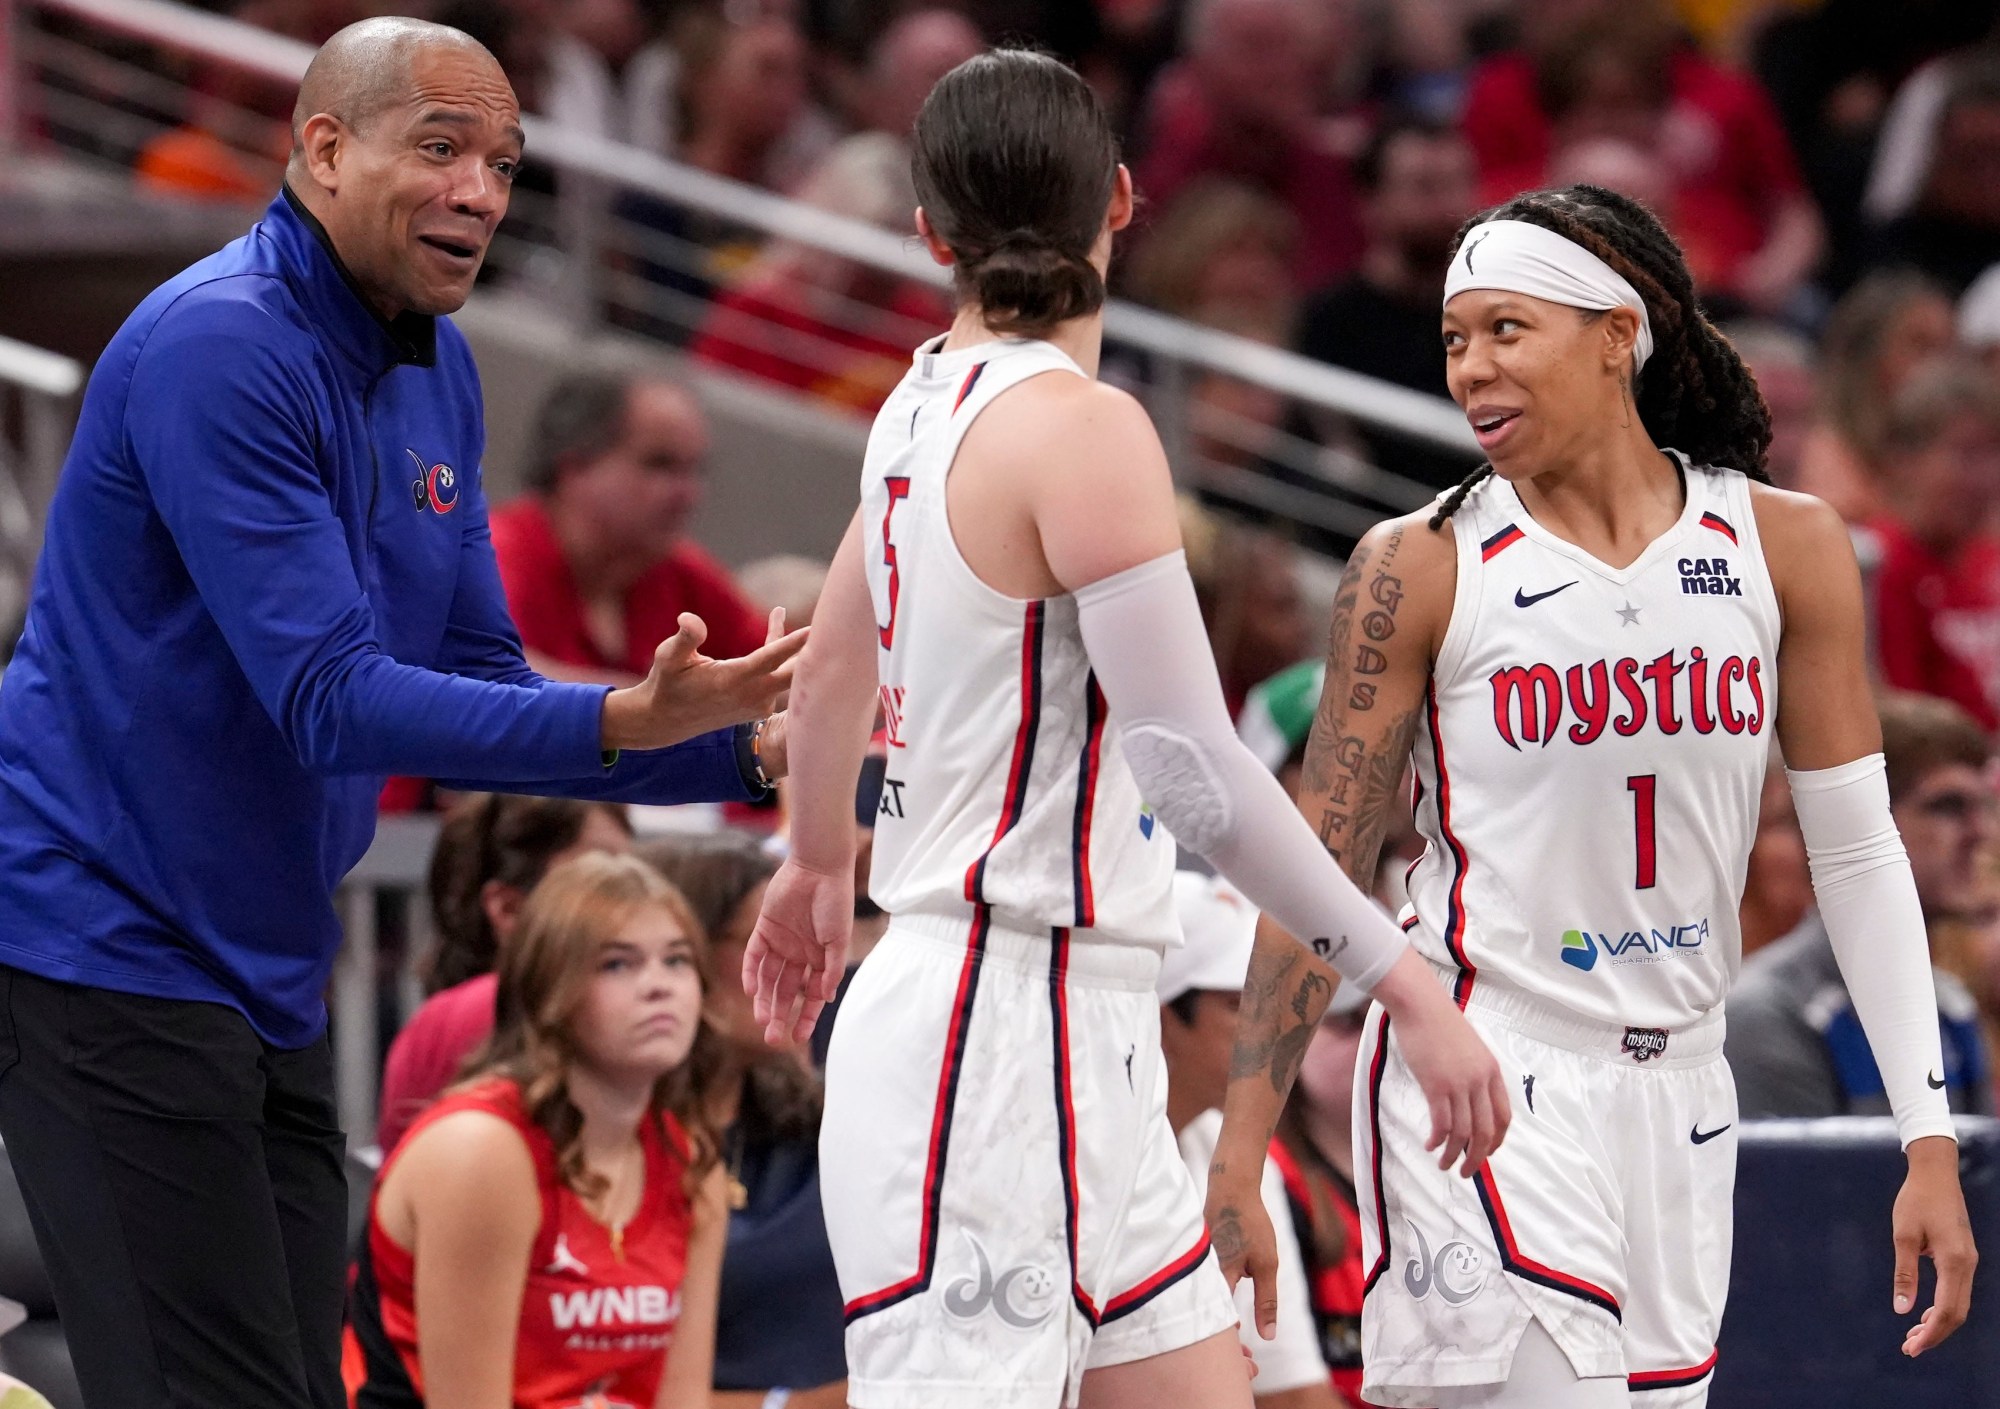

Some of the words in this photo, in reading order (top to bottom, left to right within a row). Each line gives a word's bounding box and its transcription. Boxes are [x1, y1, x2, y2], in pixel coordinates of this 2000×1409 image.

[1678, 558, 1729, 576] CAR
[1681, 577, 1742, 596] max
[1349, 574, 1404, 711] GODS
[1627, 774, 1656, 889] 1
[1598, 918, 1709, 956] VANDA
